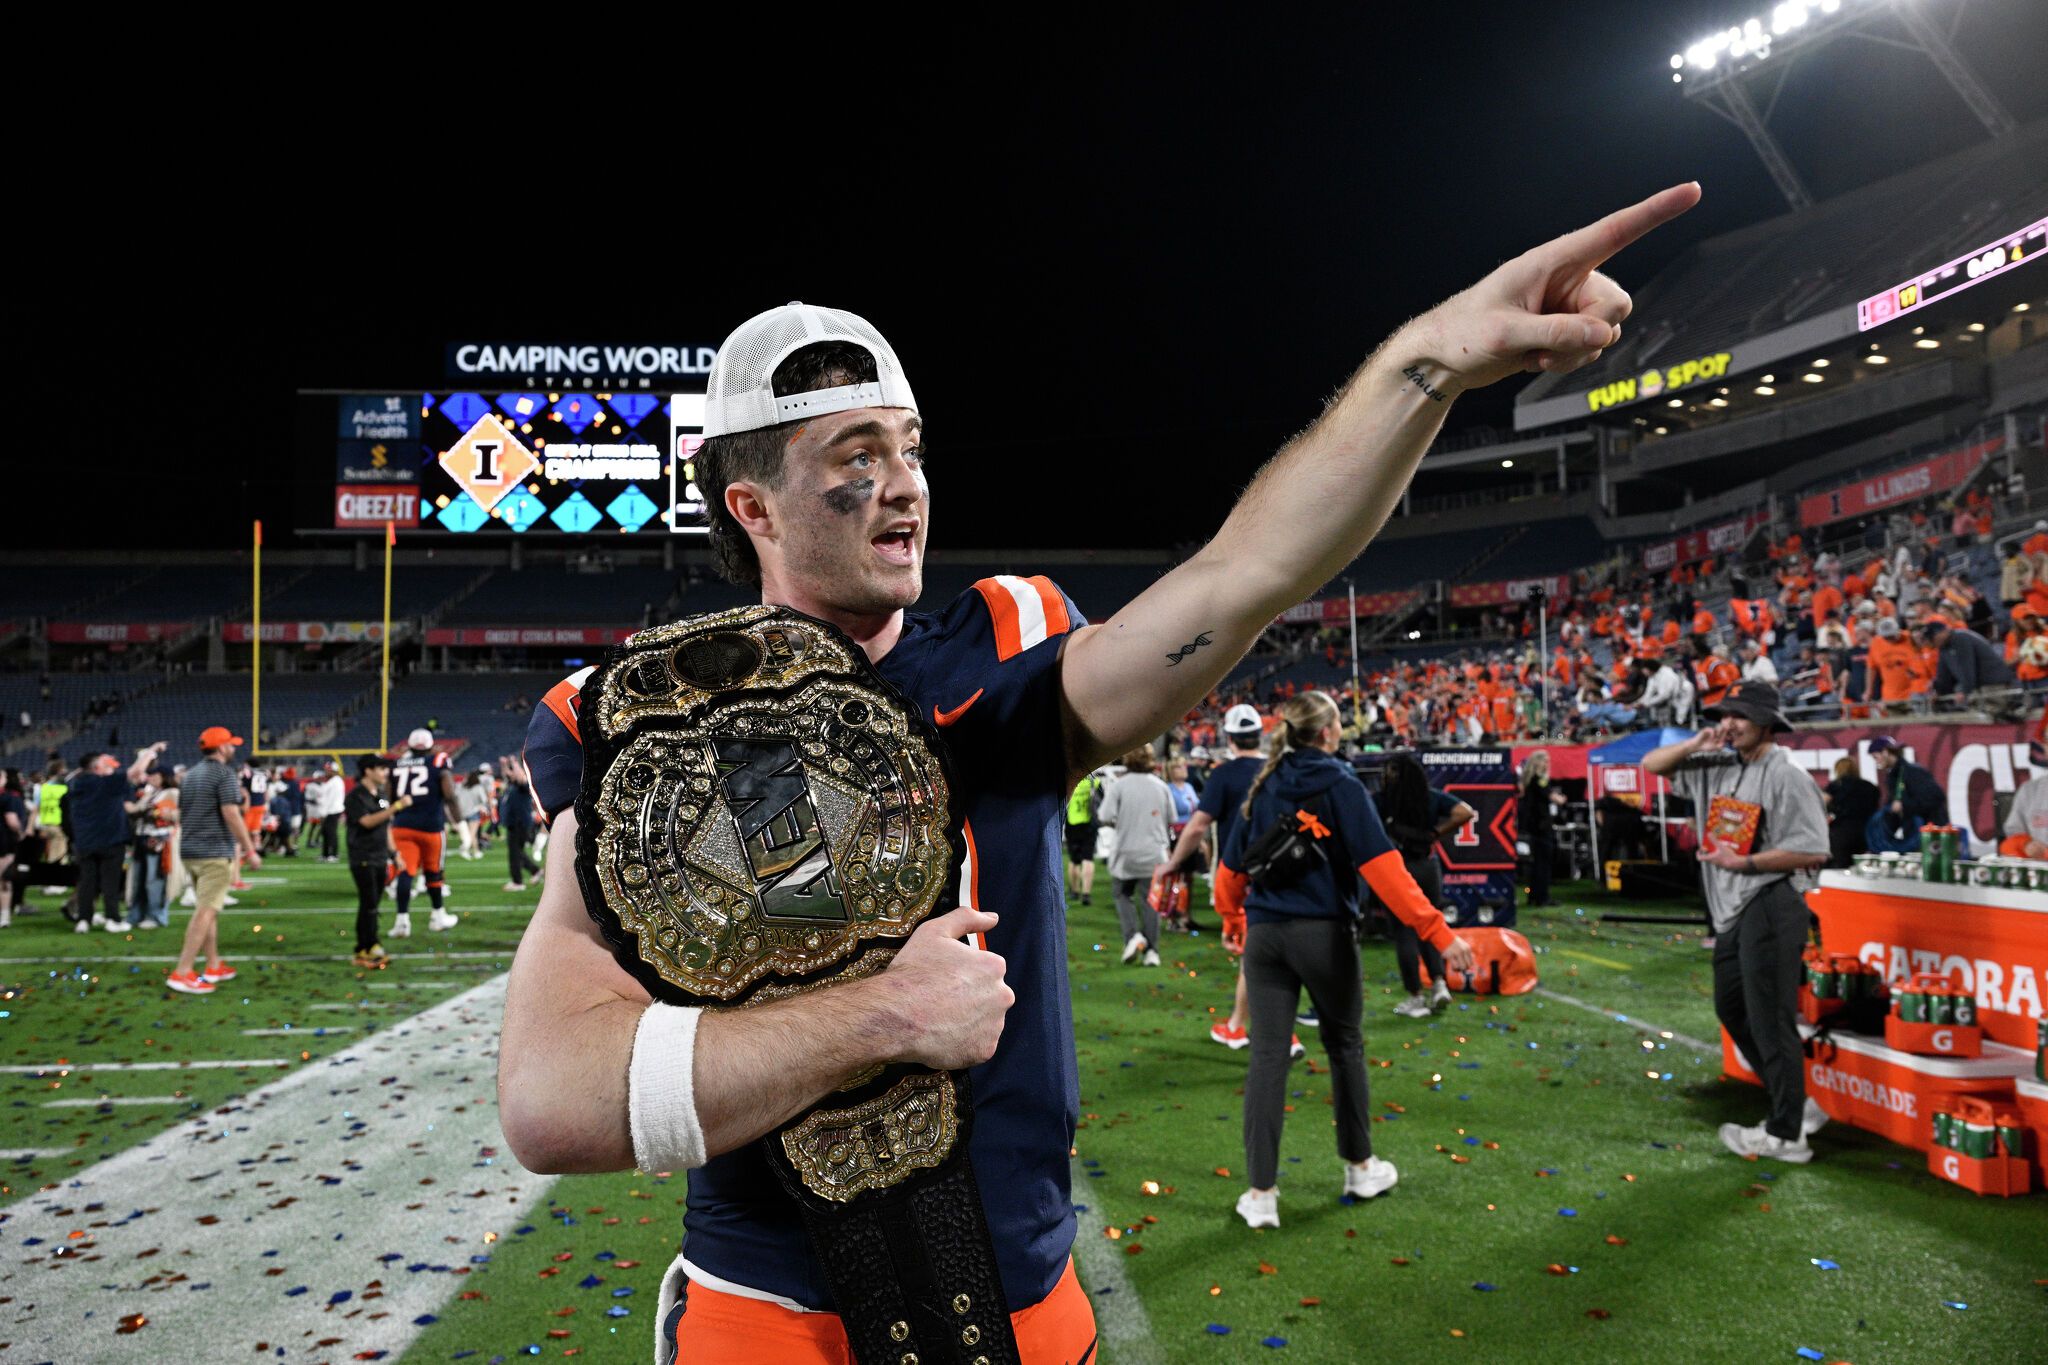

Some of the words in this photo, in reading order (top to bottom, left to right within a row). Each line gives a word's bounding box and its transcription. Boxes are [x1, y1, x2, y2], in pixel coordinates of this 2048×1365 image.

[456, 345, 600, 372] CAMPING
[604, 347, 717, 373] WORLD
[527, 378, 650, 388] STADIUM
[1587, 378, 1637, 412] FUN
[1666, 352, 1732, 389] SPOT
[352, 409, 407, 424] Advent
[356, 425, 408, 438] Health
[1864, 466, 1931, 505] ILLINOIS
[392, 765, 429, 797] 72
[706, 739, 850, 921] AEW
[1859, 941, 2048, 1019] GATORA
[1932, 1029, 1954, 1051] G
[1811, 1063, 1918, 1119] GATORADE
[1943, 1155, 1960, 1180] G
